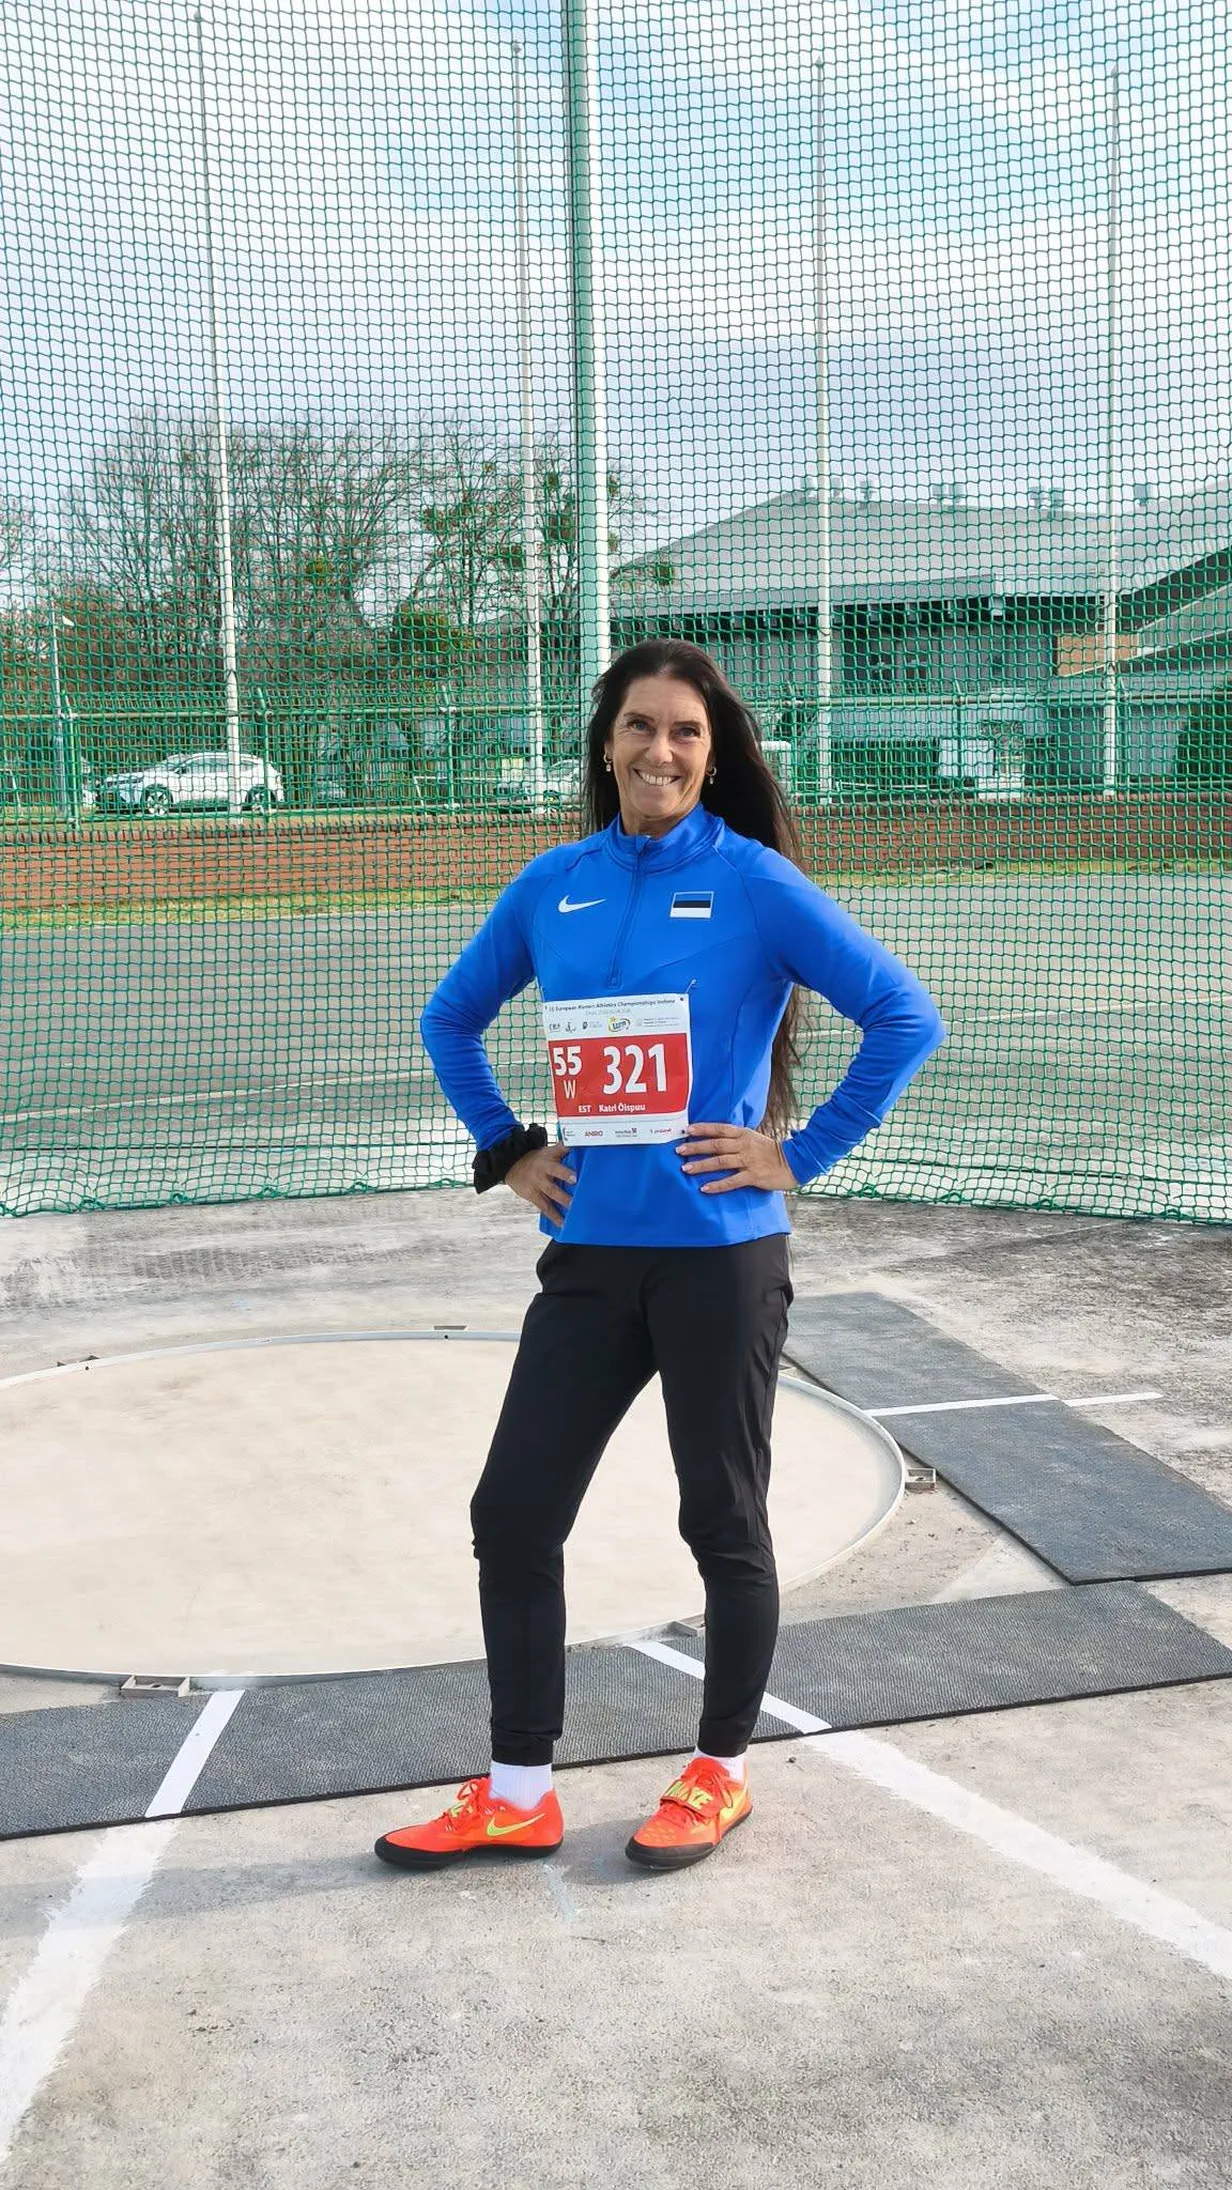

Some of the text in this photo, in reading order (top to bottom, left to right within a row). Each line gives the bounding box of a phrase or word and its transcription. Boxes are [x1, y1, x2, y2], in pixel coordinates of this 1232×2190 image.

[617, 1000, 656, 1008] Championships
[552, 1045, 583, 1076] 55
[602, 1043, 668, 1095] 321
[563, 1079, 576, 1100] W
[578, 1105, 592, 1113] EST
